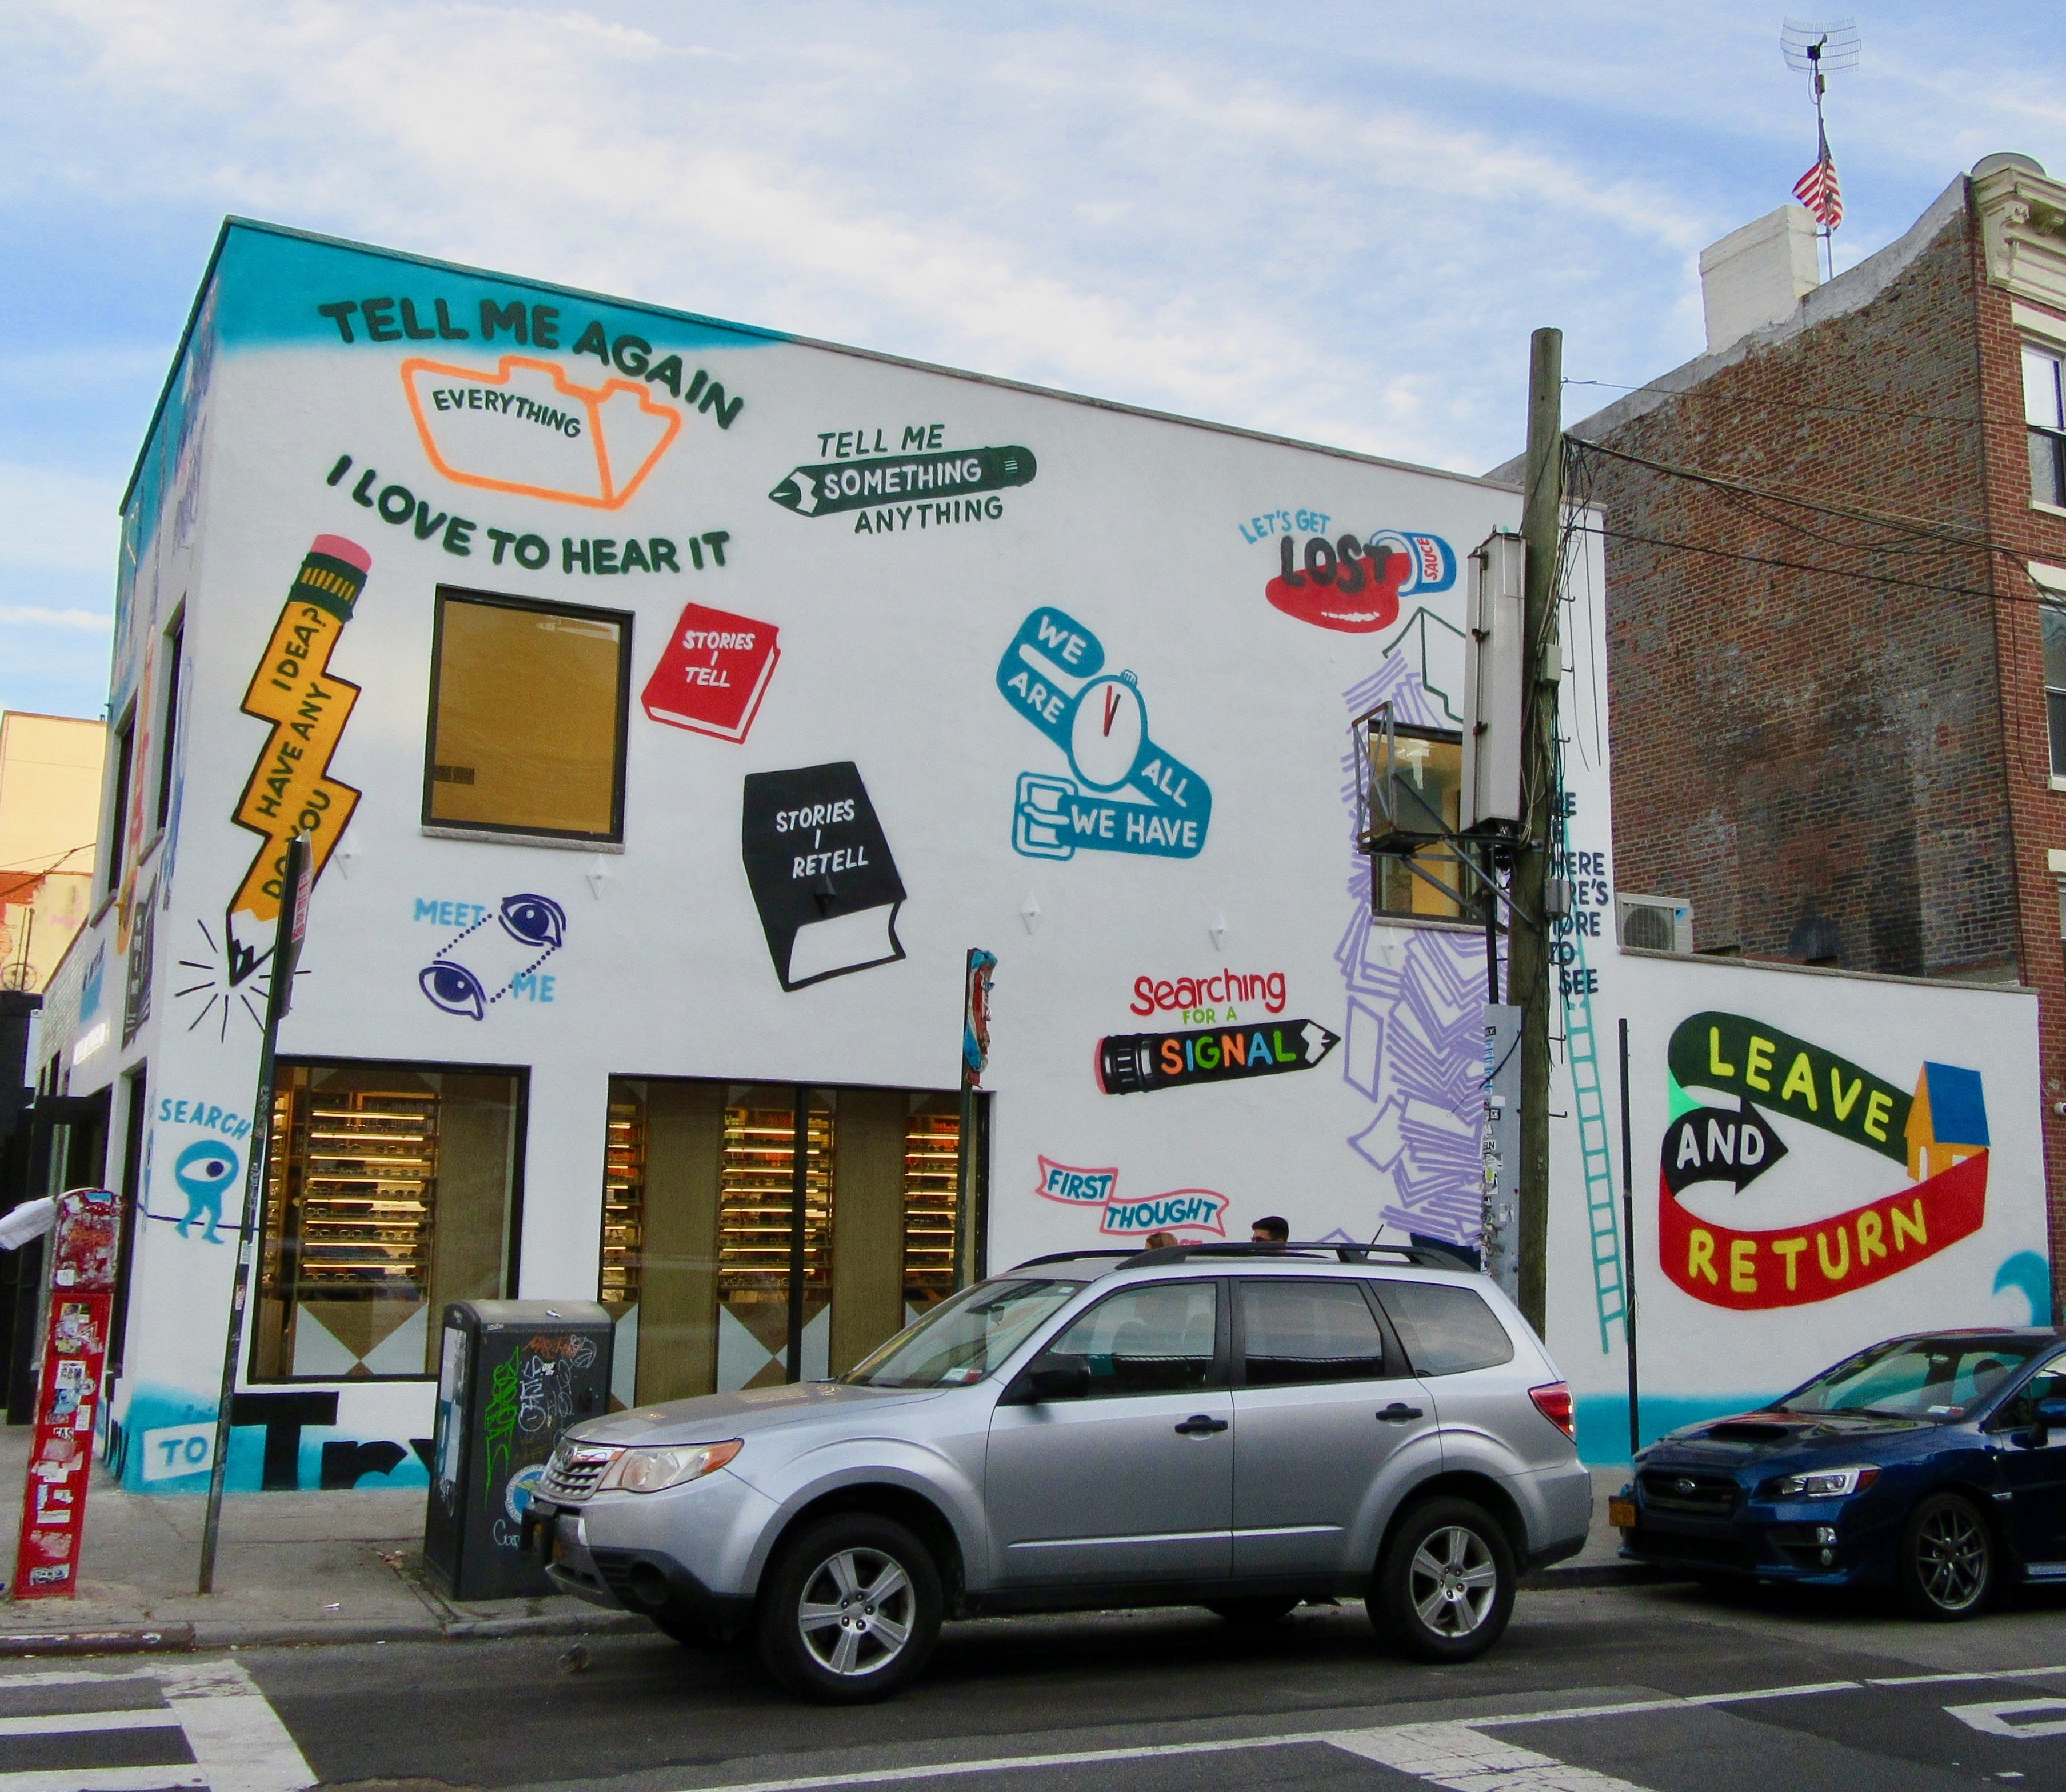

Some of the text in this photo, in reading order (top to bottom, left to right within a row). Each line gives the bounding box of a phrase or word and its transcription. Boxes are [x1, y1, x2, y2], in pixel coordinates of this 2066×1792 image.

[319, 298, 744, 430] TELL ME AGAIN
[433, 389, 581, 438] EVERYTHING
[818, 424, 945, 458] TELL ME
[824, 459, 982, 499] SOMETHING
[327, 455, 730, 575] I LOVE TO HEAR IT
[854, 495, 1004, 534] ANYTHING
[1239, 509, 1331, 545] LET'S GET
[1280, 534, 1393, 595] LOST
[1416, 537, 1438, 581] SAUCE
[271, 606, 327, 692] IDEA?
[682, 630, 756, 650] STORIES
[710, 651, 718, 666] I
[1037, 615, 1086, 665] WE
[685, 666, 731, 688] TELL
[1007, 672, 1065, 725] ARE
[256, 741, 303, 818] HAVE
[290, 682, 333, 741] ANY
[1141, 758, 1189, 808] ALL
[776, 798, 855, 833] STORIES
[1071, 804, 1198, 848] WE HAVE
[814, 829, 821, 849] I
[792, 846, 869, 879] RETELL
[413, 898, 485, 928] MEET
[513, 972, 556, 1003] ME
[1130, 967, 1286, 1017] Searching
[1558, 969, 1599, 995] SEE
[1182, 1006, 1238, 1025] FOR A
[1161, 1030, 1296, 1075] SIGNAL
[1709, 1027, 1893, 1142] LEAVE
[158, 1099, 252, 1141] SEARCH
[1677, 1119, 1765, 1170] AND
[1047, 1170, 1112, 1199] FIRST
[1107, 1198, 1218, 1229] THOUGHT
[1688, 1199, 1928, 1293] RETURN
[158, 1436, 208, 1466] TO
